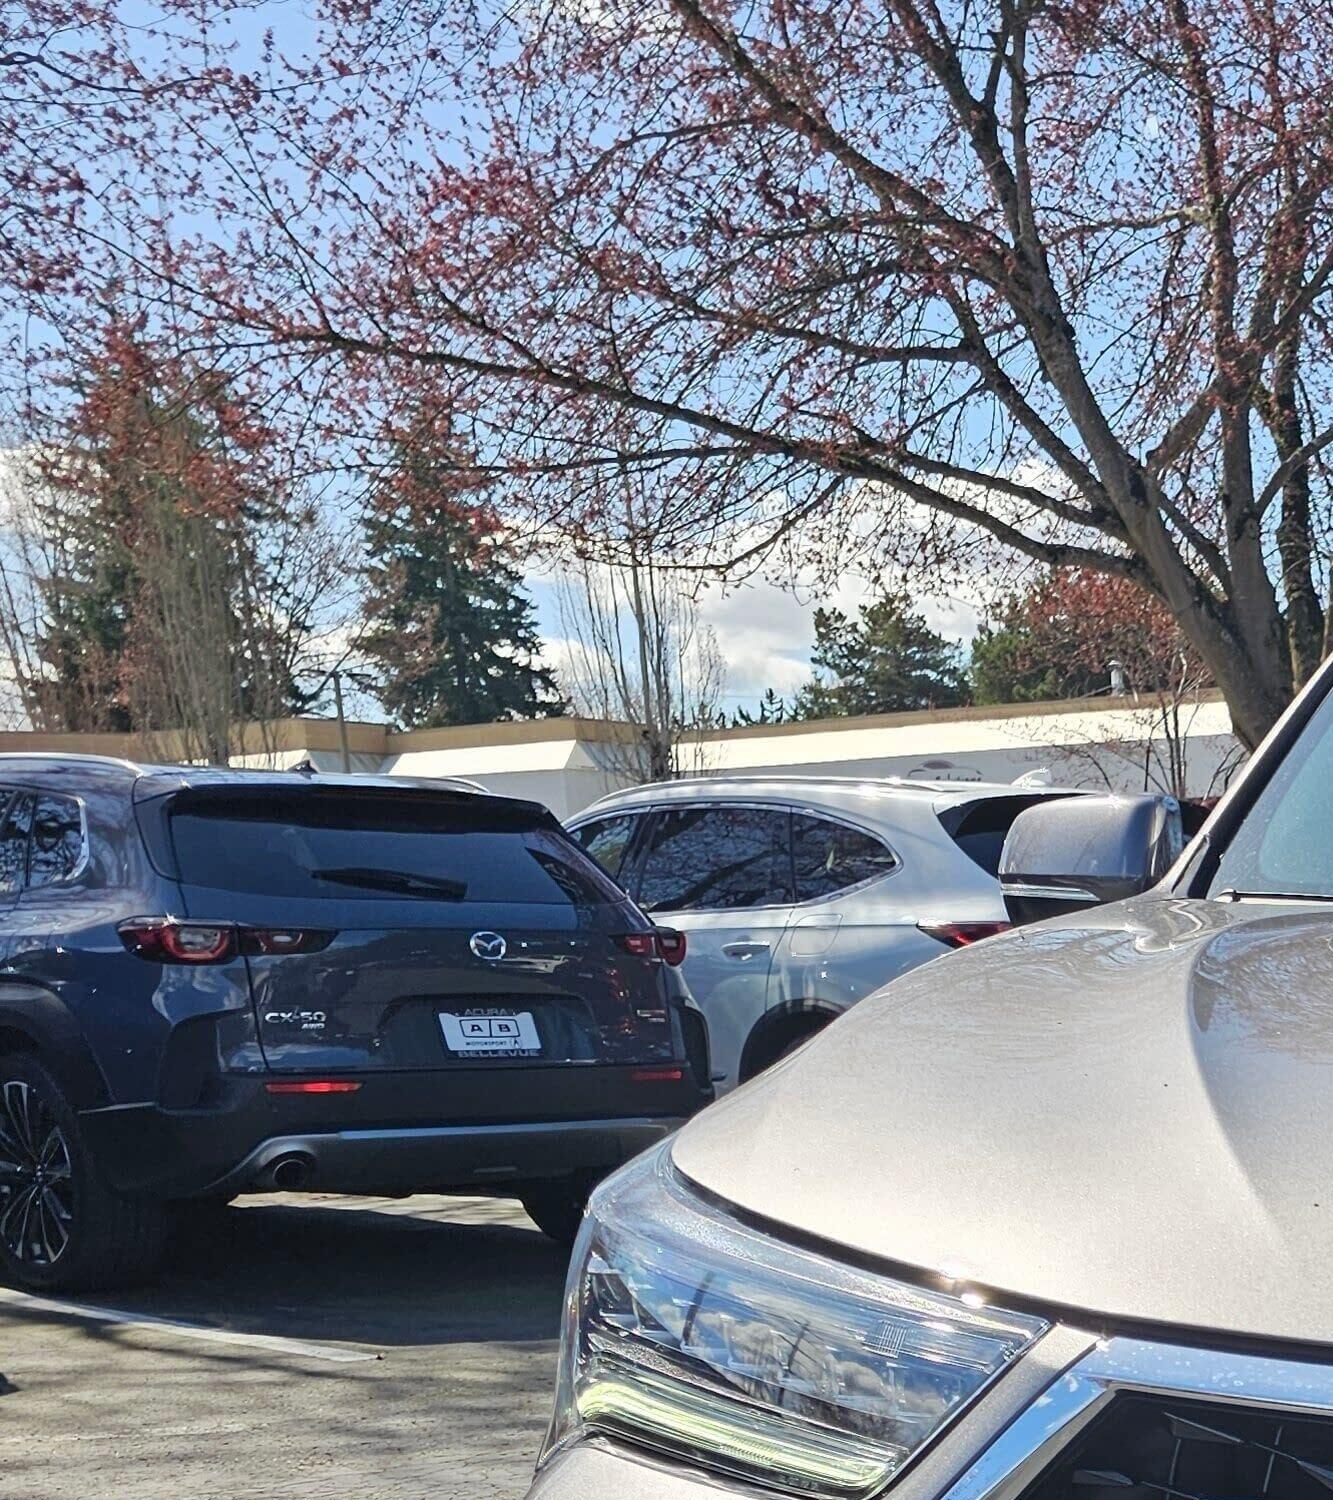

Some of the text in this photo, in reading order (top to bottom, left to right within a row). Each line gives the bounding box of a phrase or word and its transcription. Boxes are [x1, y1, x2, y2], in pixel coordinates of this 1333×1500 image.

[464, 1008, 508, 1017] ACURA
[264, 1011, 327, 1024] CX-50
[458, 1049, 540, 1058] BELLEVUE
